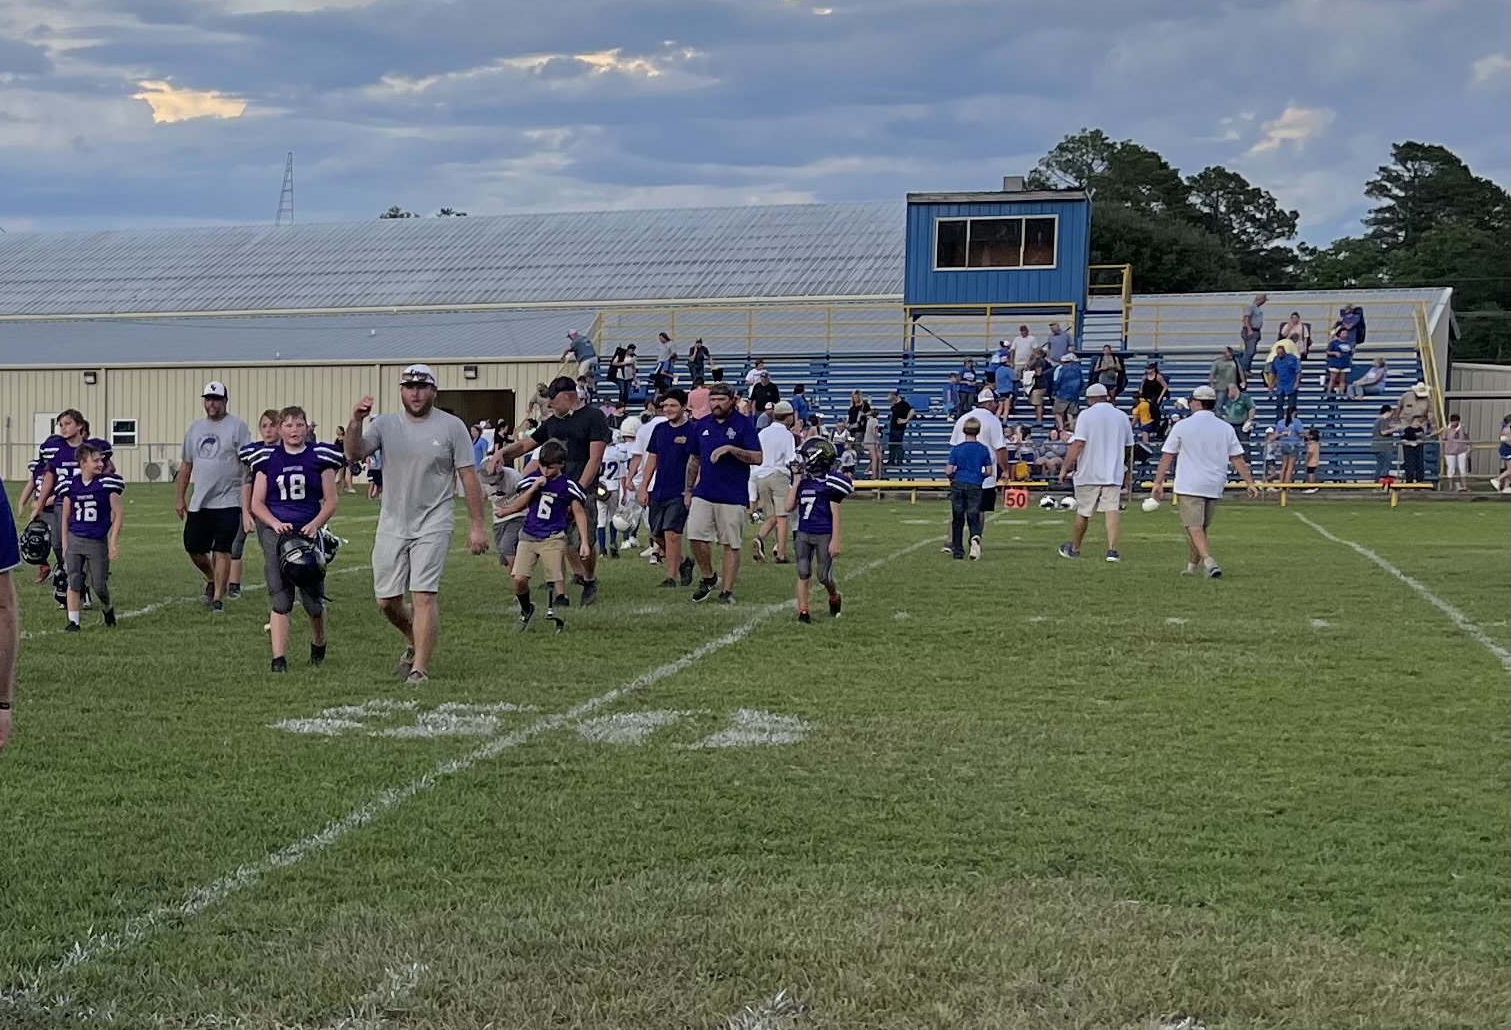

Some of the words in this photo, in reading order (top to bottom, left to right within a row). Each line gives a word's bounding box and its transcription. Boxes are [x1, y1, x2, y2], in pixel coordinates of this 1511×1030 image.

[276, 474, 305, 500] 18
[74, 501, 97, 521] 16
[537, 493, 554, 519] 6
[800, 496, 816, 520] 7
[1006, 492, 1025, 507] 50
